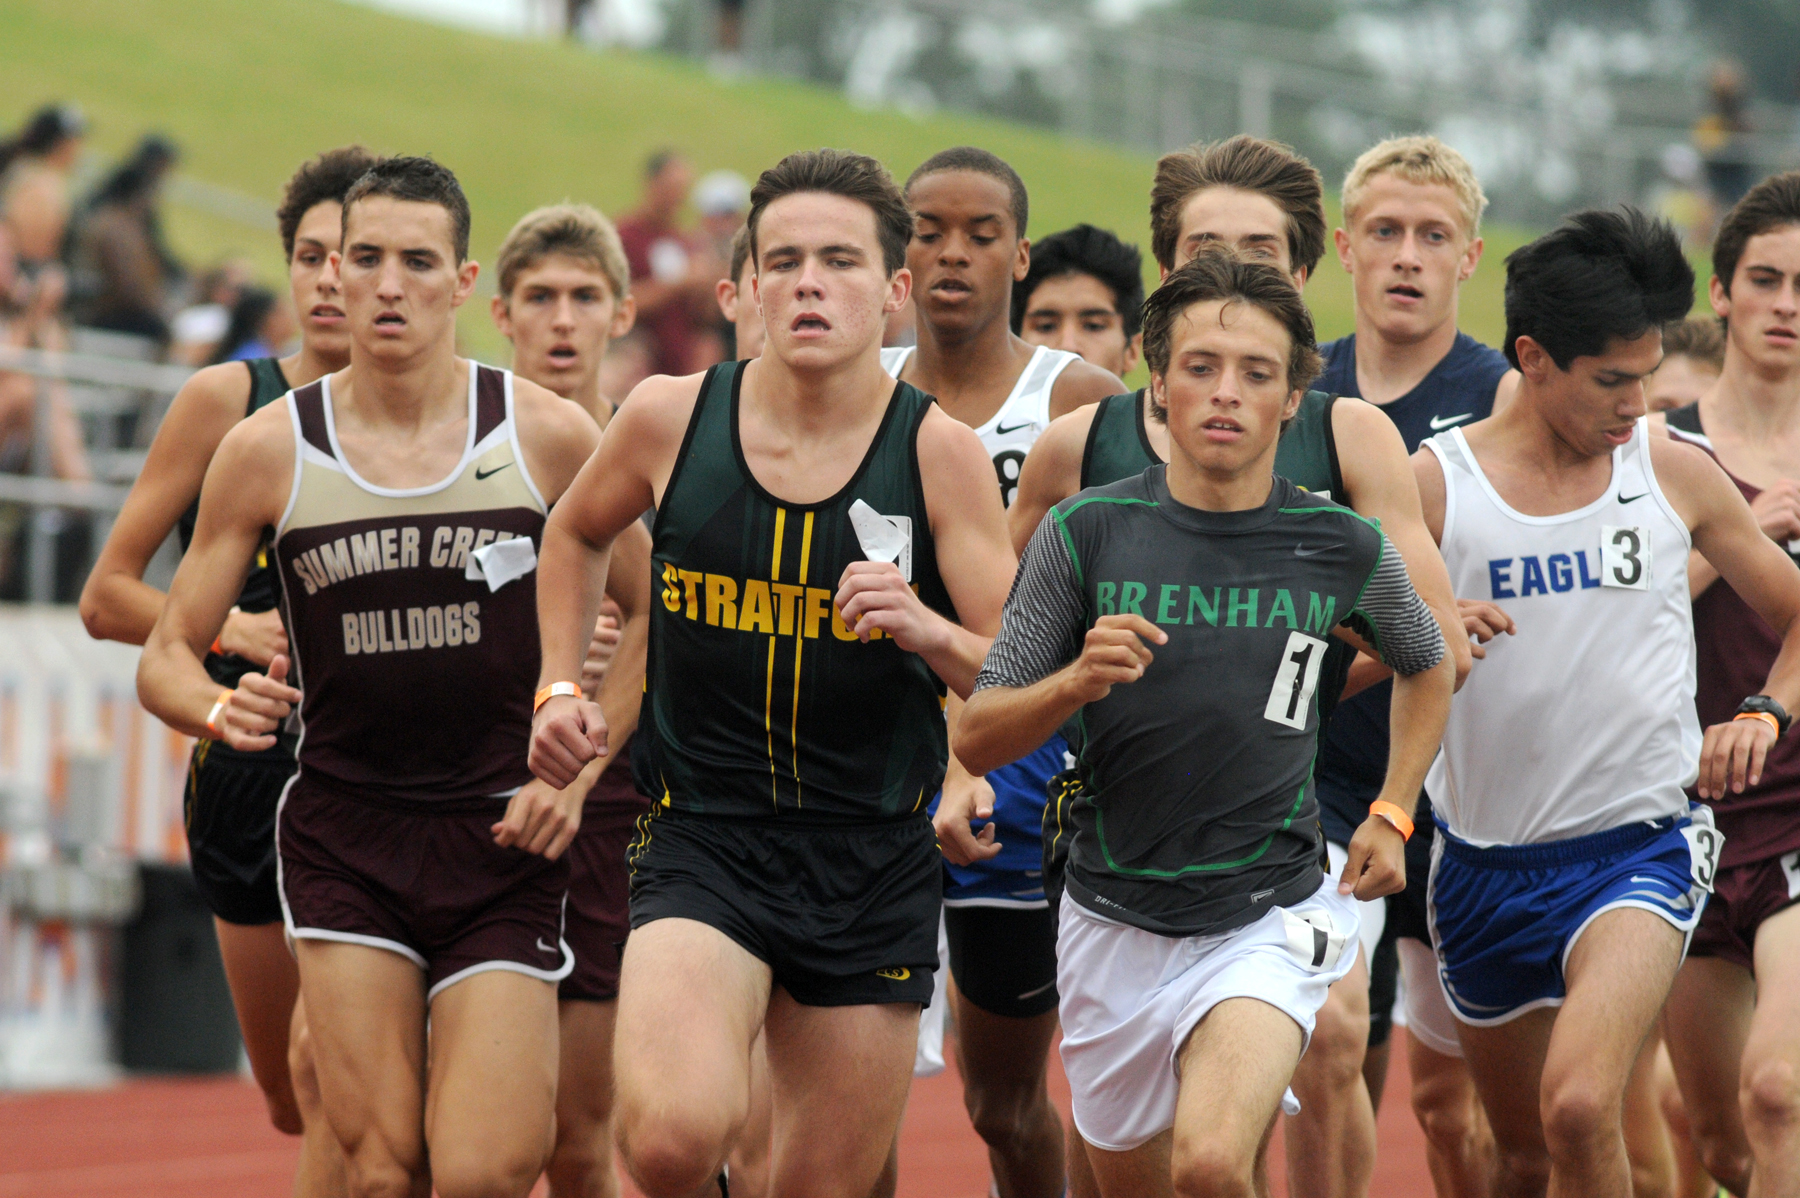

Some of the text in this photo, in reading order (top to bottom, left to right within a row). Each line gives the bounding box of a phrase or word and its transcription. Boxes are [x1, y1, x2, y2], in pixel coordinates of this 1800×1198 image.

[293, 526, 523, 595] SUMMER CRE
[1488, 547, 1602, 600] EAGL
[1612, 529, 1642, 585] 3
[342, 601, 481, 655] BULLDOGS
[662, 562, 919, 641] STRATF
[1097, 581, 1336, 636] BRENHAM
[1286, 643, 1314, 720] 1
[1696, 829, 1715, 885] 3
